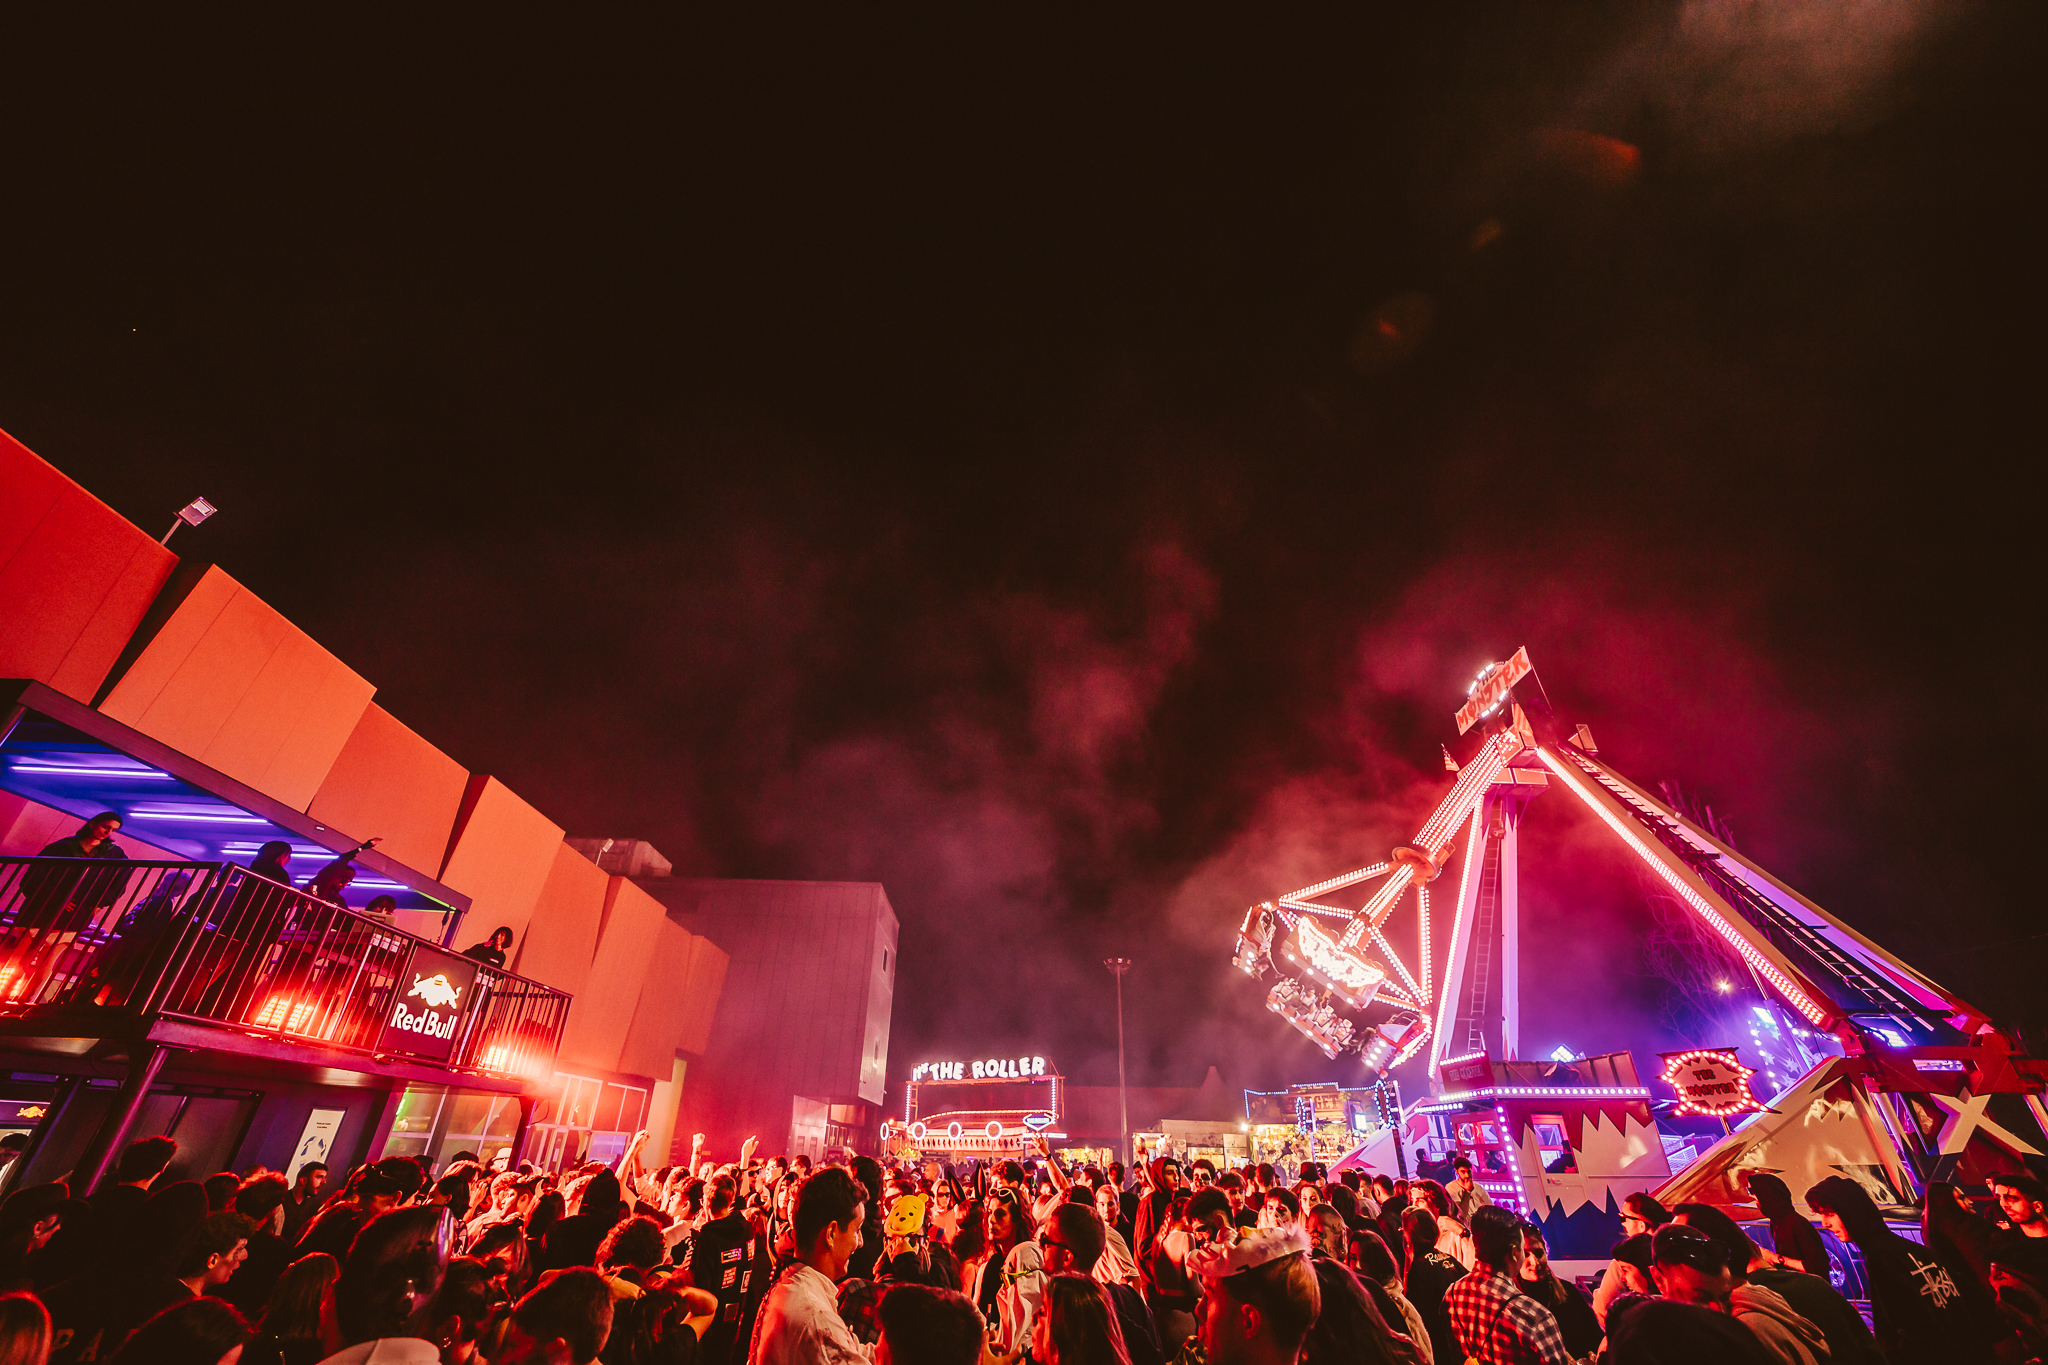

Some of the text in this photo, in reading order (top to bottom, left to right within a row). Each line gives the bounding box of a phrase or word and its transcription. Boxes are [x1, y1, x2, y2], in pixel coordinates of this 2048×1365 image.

[1457, 651, 1529, 729] MONSTER
[390, 1002, 458, 1040] Red Bull
[929, 1061, 964, 1081] THE
[971, 1056, 1045, 1079] ROLLER
[1692, 1069, 1716, 1081] THE
[1685, 1082, 1738, 1097] MONSTER
